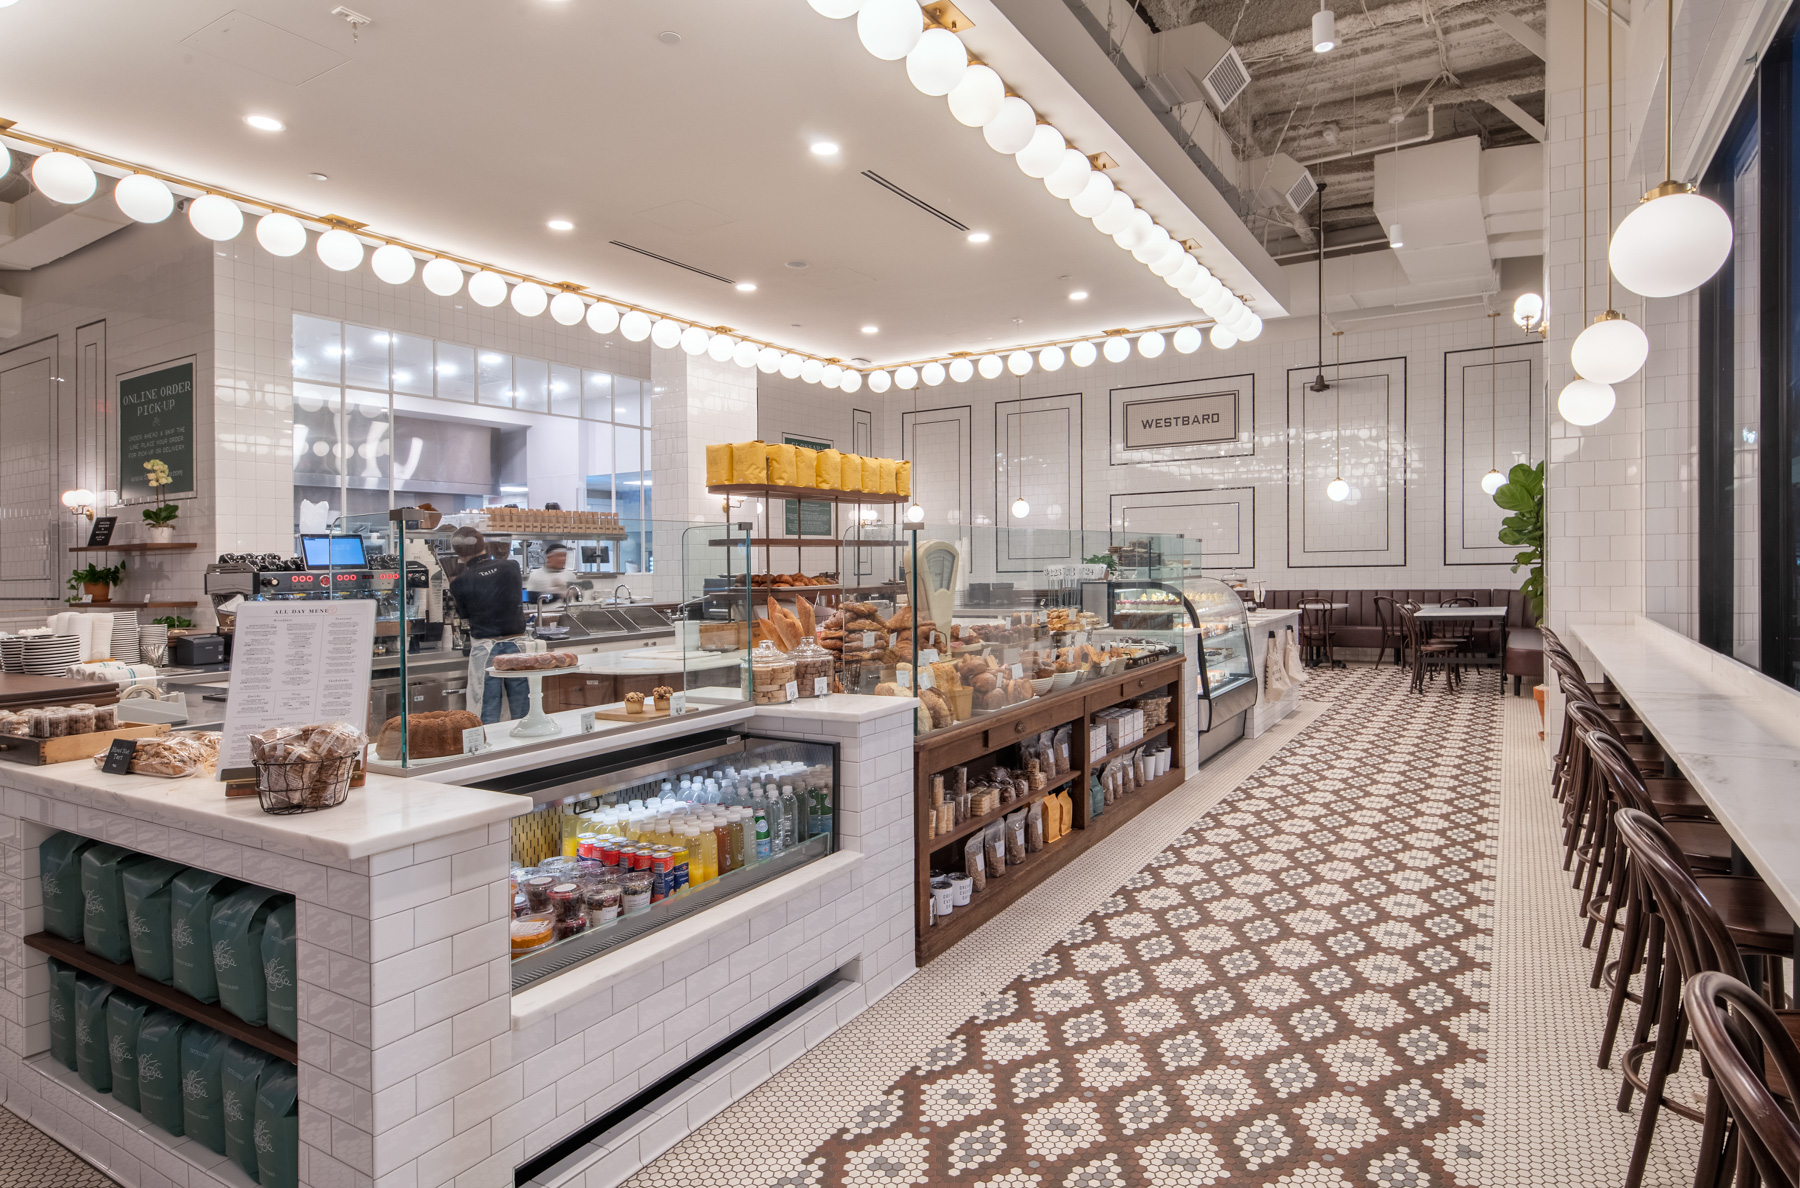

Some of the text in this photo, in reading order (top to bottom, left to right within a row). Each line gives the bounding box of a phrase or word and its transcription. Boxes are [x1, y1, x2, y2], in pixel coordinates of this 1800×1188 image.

[122, 380, 192, 406] ONLINE ORDER
[137, 399, 175, 417] PICK-UP
[1141, 412, 1220, 429] WESTBARD
[143, 431, 158, 440] AHEAD
[164, 428, 175, 437] SKIP
[129, 435, 184, 451] LINE PLACE YOUR ORDER
[128, 451, 137, 459] FOR
[784, 812, 792, 845] Tatte
